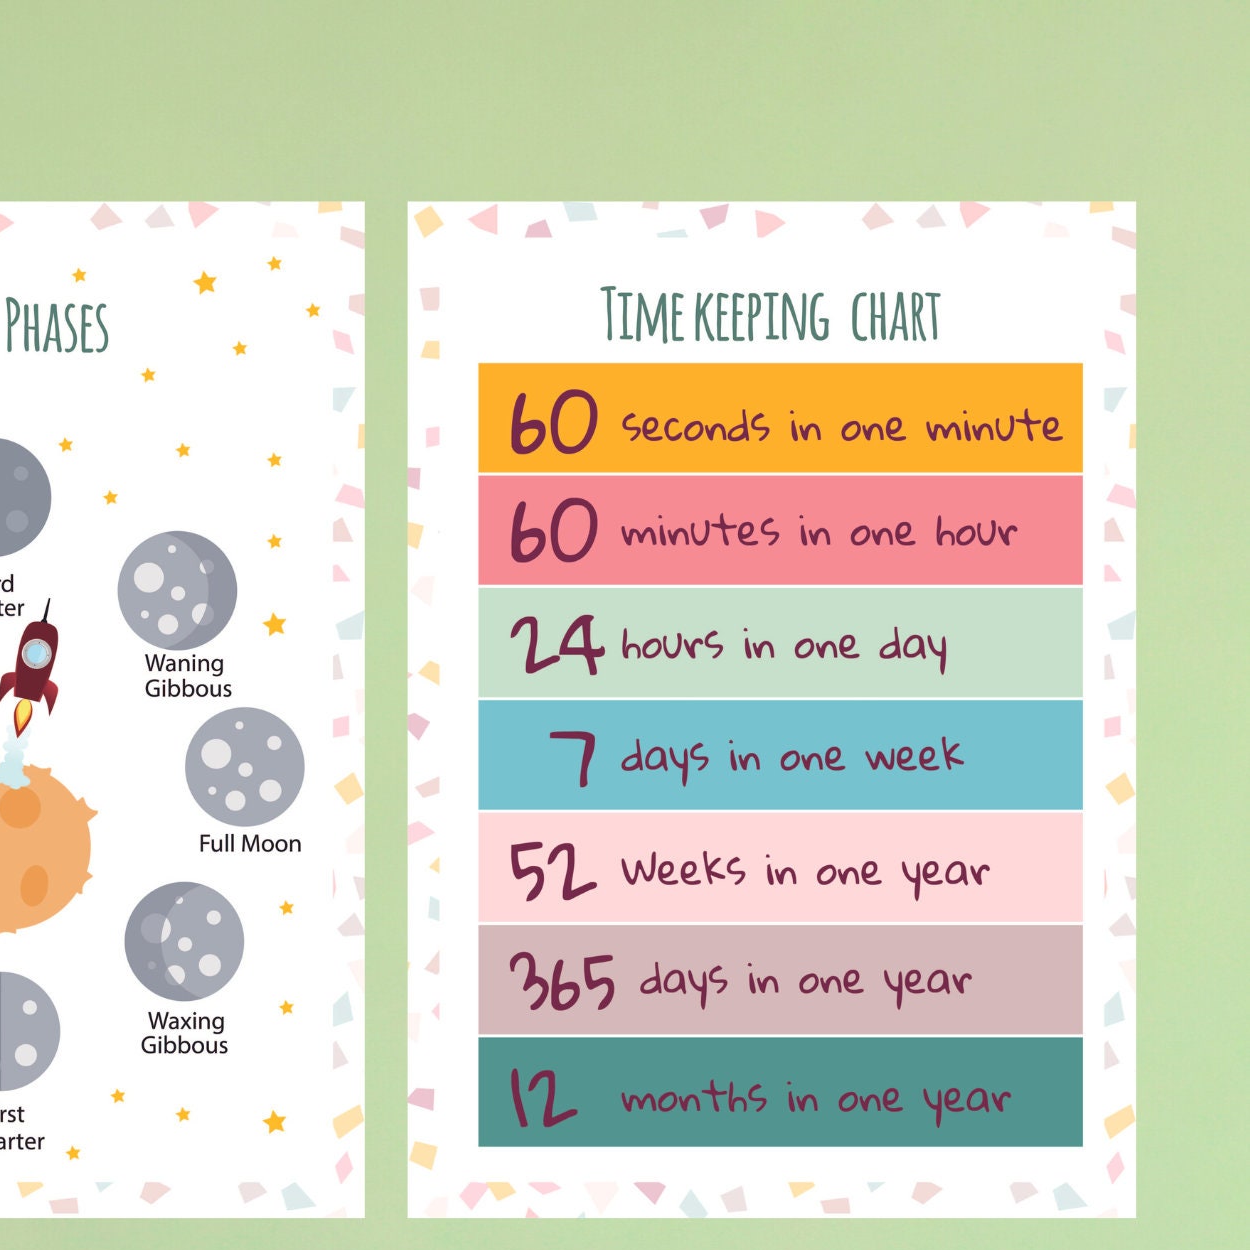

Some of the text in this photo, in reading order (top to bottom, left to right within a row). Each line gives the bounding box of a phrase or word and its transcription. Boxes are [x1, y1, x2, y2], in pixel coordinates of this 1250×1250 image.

[510, 388, 1064, 455] 60 seconds in one minute
[510, 497, 1018, 564] 60 minutes in one hour
[144, 653, 224, 679] Waning
[510, 614, 947, 676] 24 hours in one day
[145, 676, 232, 698] Gibbous
[549, 730, 965, 788] 7 days in one week
[200, 833, 302, 853] Full Moon
[510, 841, 598, 902] 52
[765, 853, 797, 886] in
[816, 860, 883, 886] one
[901, 860, 991, 902] year
[509, 951, 973, 1012] 365 days in one year
[141, 1033, 229, 1055] Gibbous
[147, 1011, 225, 1036] Waxing
[510, 1067, 1012, 1129] 12 months in one year
